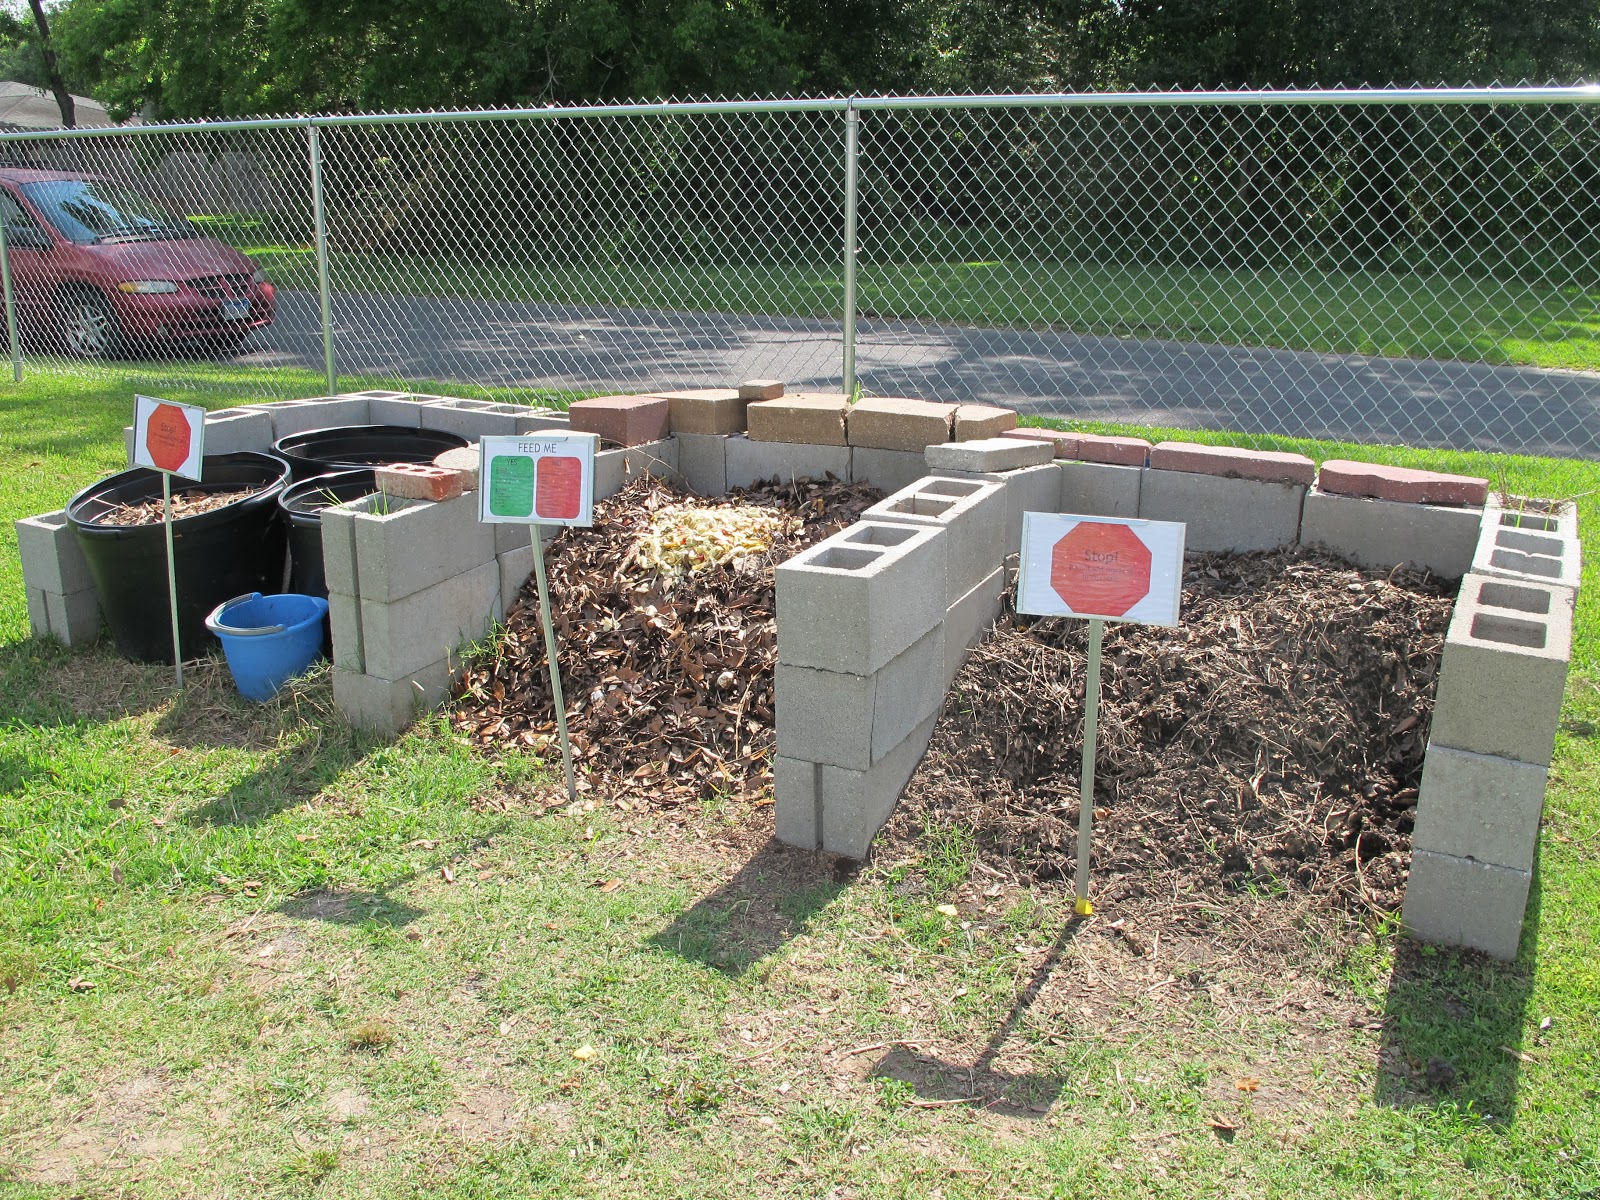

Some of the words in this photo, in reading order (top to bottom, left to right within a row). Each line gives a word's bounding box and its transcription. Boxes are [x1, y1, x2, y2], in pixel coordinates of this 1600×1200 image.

[518, 442, 541, 453] FEED
[543, 443, 558, 454] ME
[507, 458, 518, 466] YES
[552, 459, 562, 467] NO
[1085, 549, 1118, 565] Stop!
